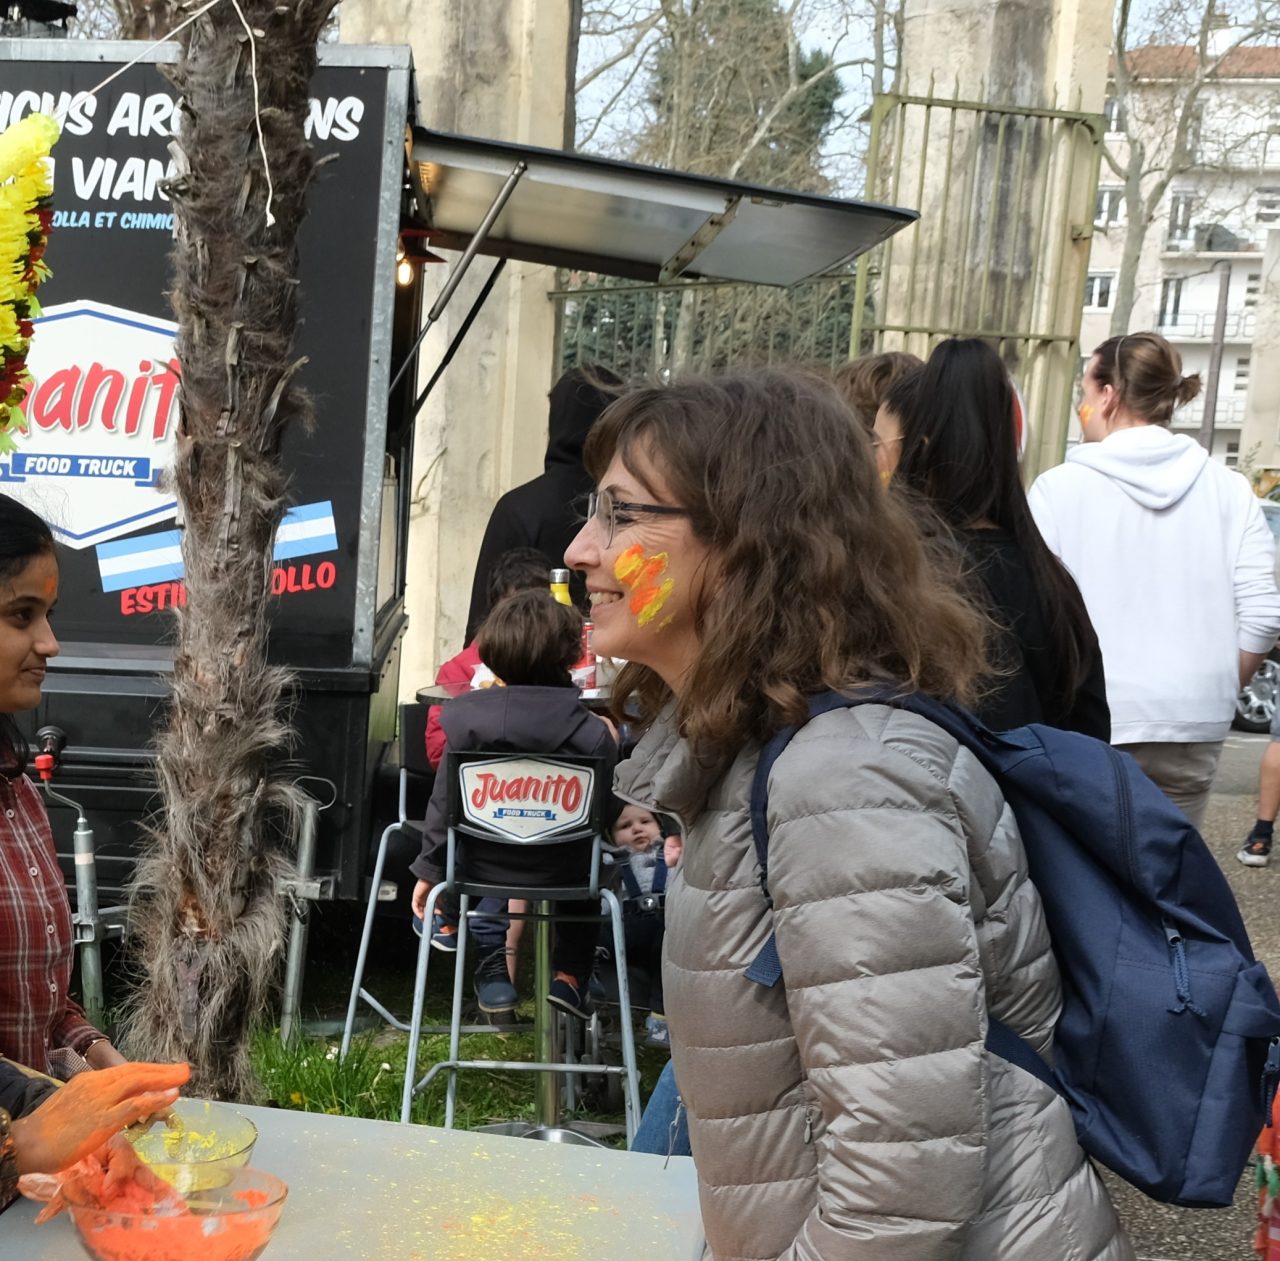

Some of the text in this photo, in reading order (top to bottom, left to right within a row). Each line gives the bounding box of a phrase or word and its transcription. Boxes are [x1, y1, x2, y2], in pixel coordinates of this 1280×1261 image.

[94, 212, 118, 228] ET
[25, 456, 138, 476] FOOD TRUCK
[502, 809, 521, 817] FOOD
